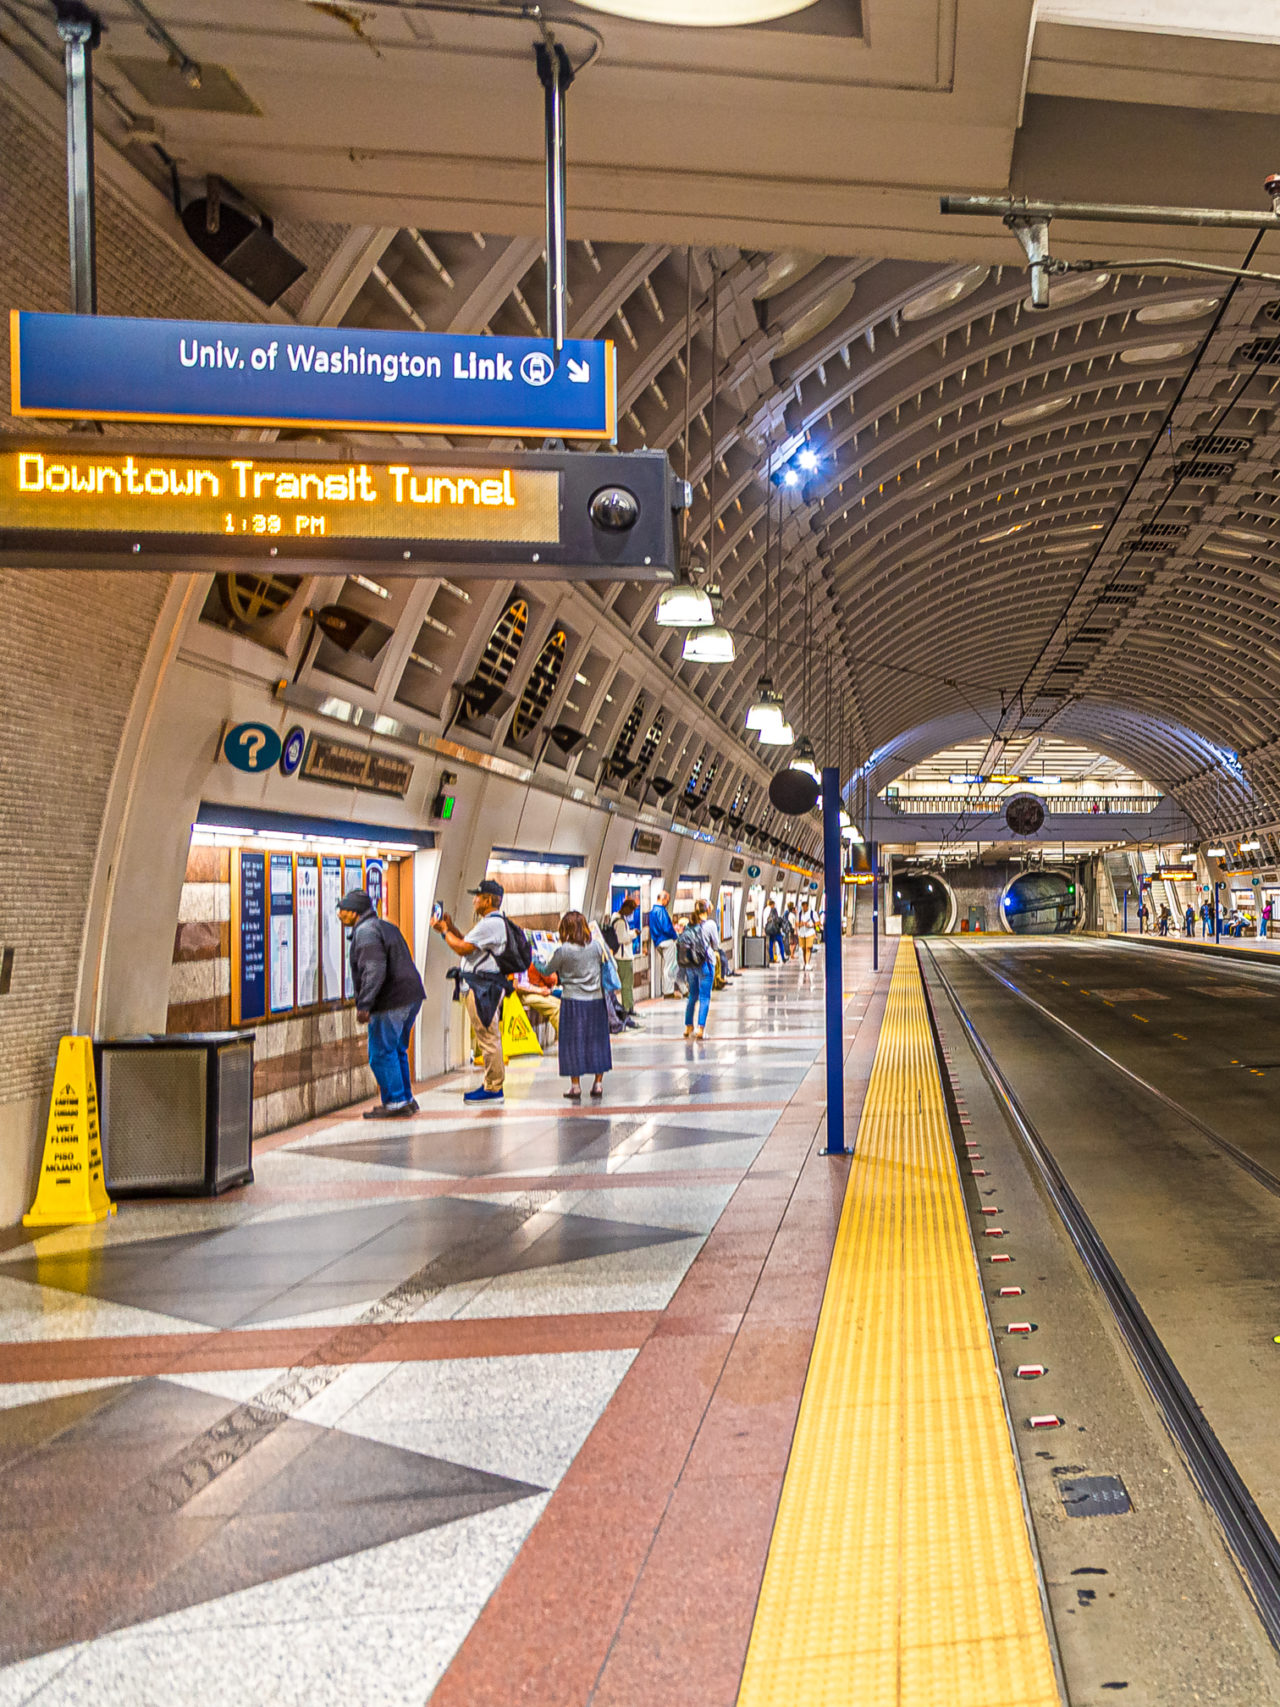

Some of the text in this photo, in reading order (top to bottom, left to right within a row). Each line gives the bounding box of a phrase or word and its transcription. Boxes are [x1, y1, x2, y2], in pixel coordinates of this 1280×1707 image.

[180, 339, 513, 382] Univ. of Washington Link
[18, 453, 516, 506] Downtown Transit Tunnel
[225, 513, 326, 535] 1:39 PM
[56, 1124, 74, 1132] WET
[51, 1136, 78, 1144] FLOOR
[46, 1163, 81, 1172] MOJADO
